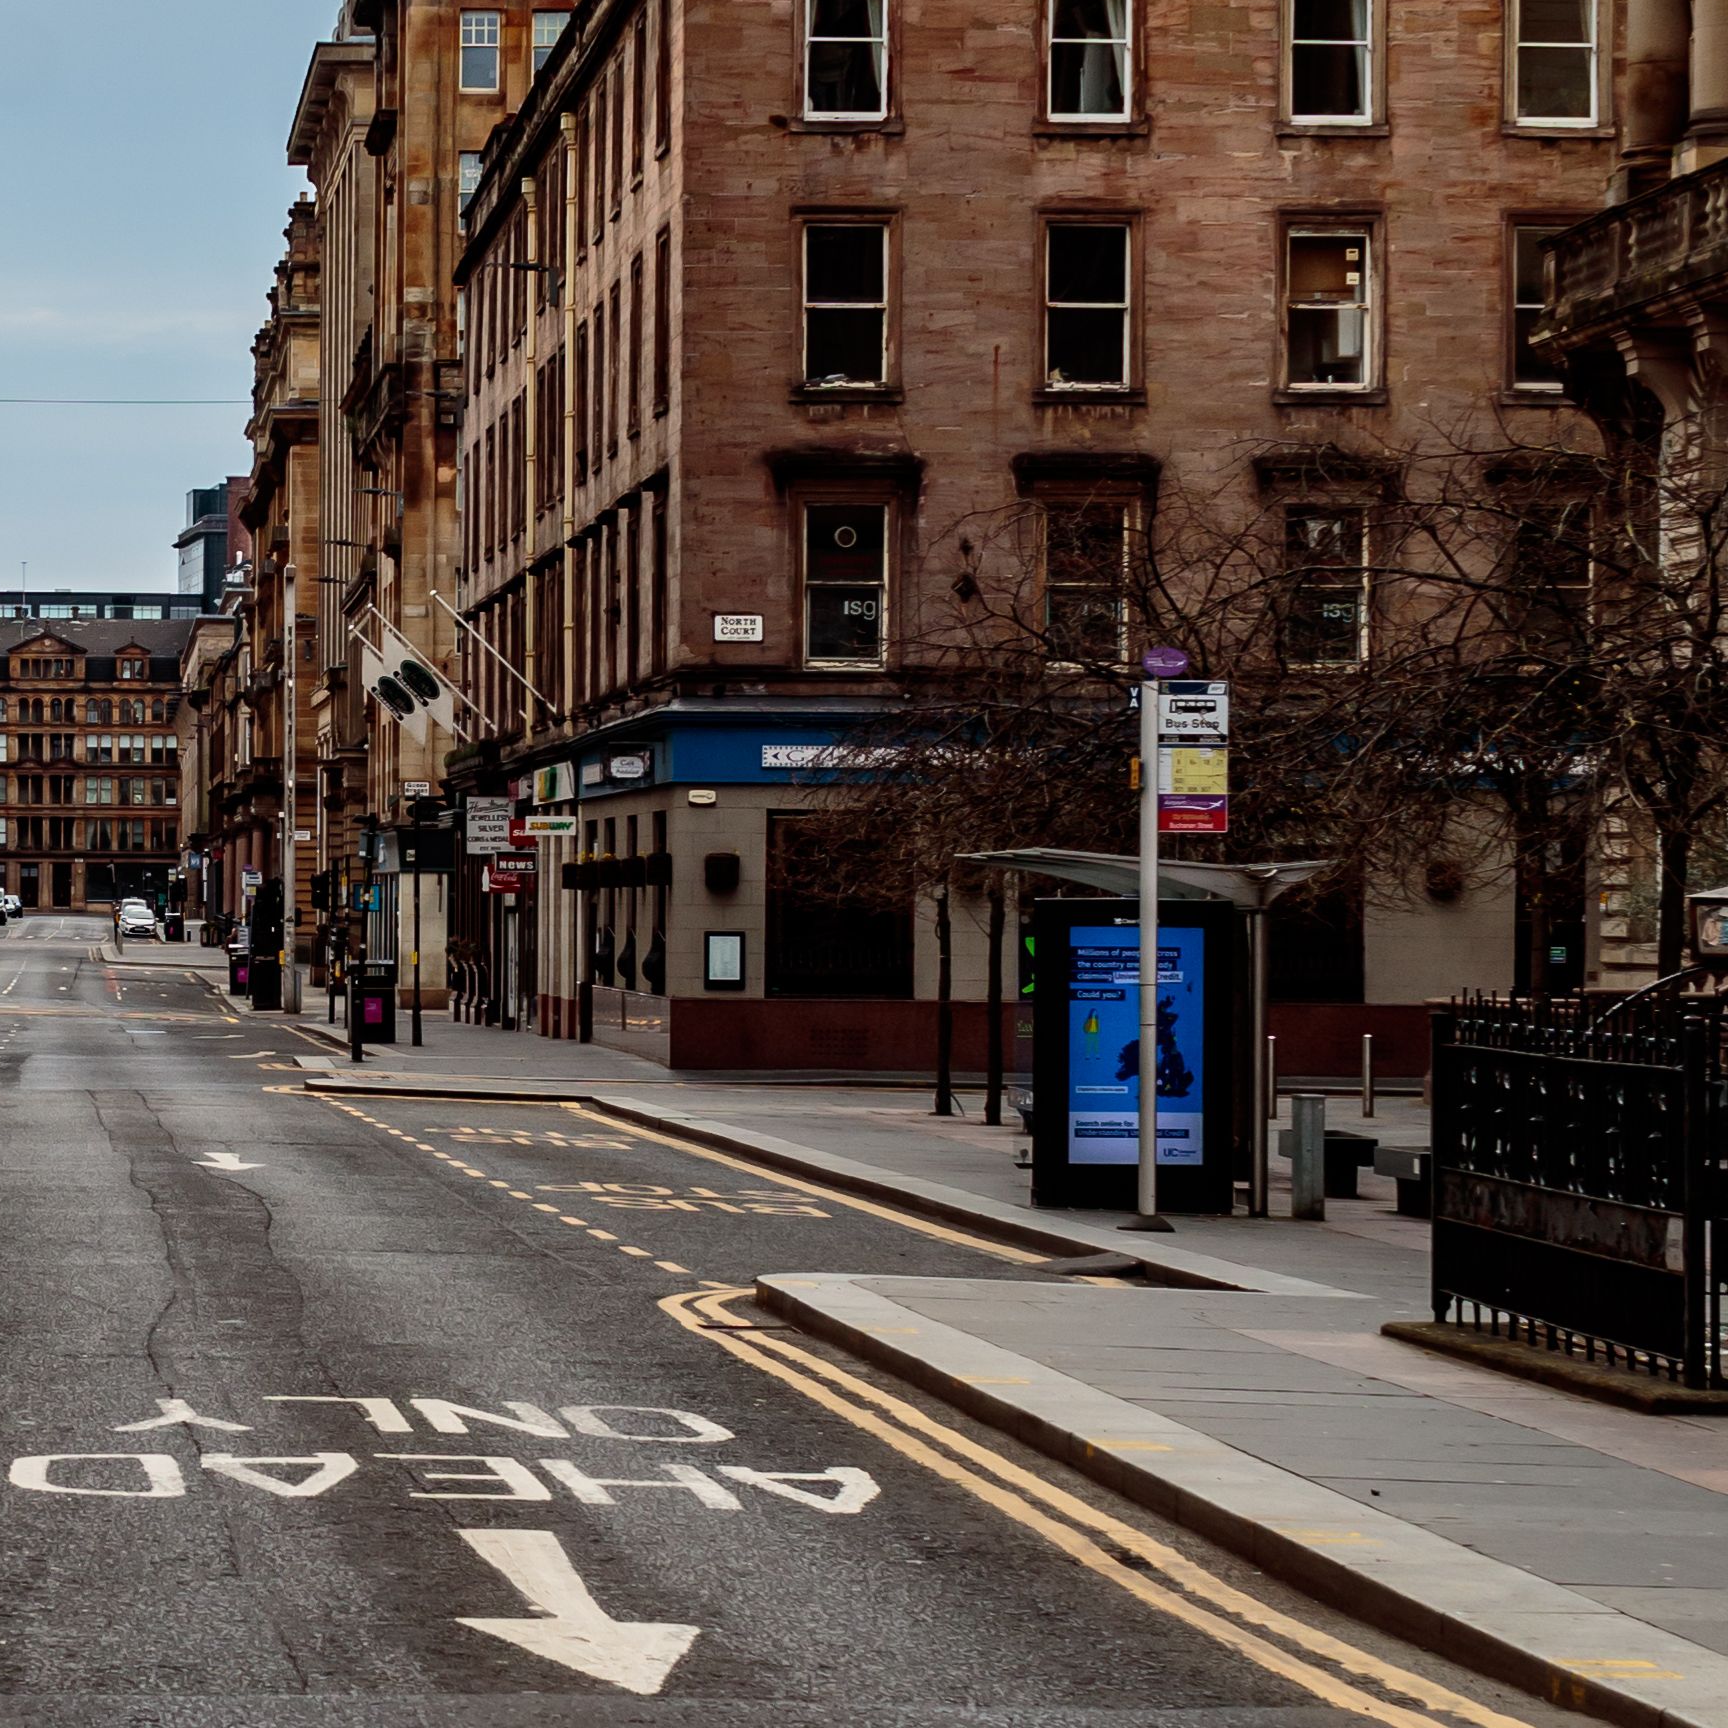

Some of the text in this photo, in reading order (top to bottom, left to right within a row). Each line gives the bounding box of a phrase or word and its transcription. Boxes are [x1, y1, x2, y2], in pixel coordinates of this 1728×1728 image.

[843, 600, 876, 620] isg
[721, 616, 757, 626] NORTH
[720, 626, 757, 635] COURT
[1165, 719, 1220, 729] Bus Stop
[529, 821, 574, 830] SUBWAY
[1111, 948, 1120, 956] of
[1092, 962, 1124, 970] country
[1077, 972, 1112, 981] claiming
[1077, 990, 1122, 1000] Could you?
[534, 1181, 819, 1203] STOP
[590, 1196, 833, 1218] BUS
[111, 1395, 735, 1443] ONLY
[8, 1452, 881, 1514] AHEAD
